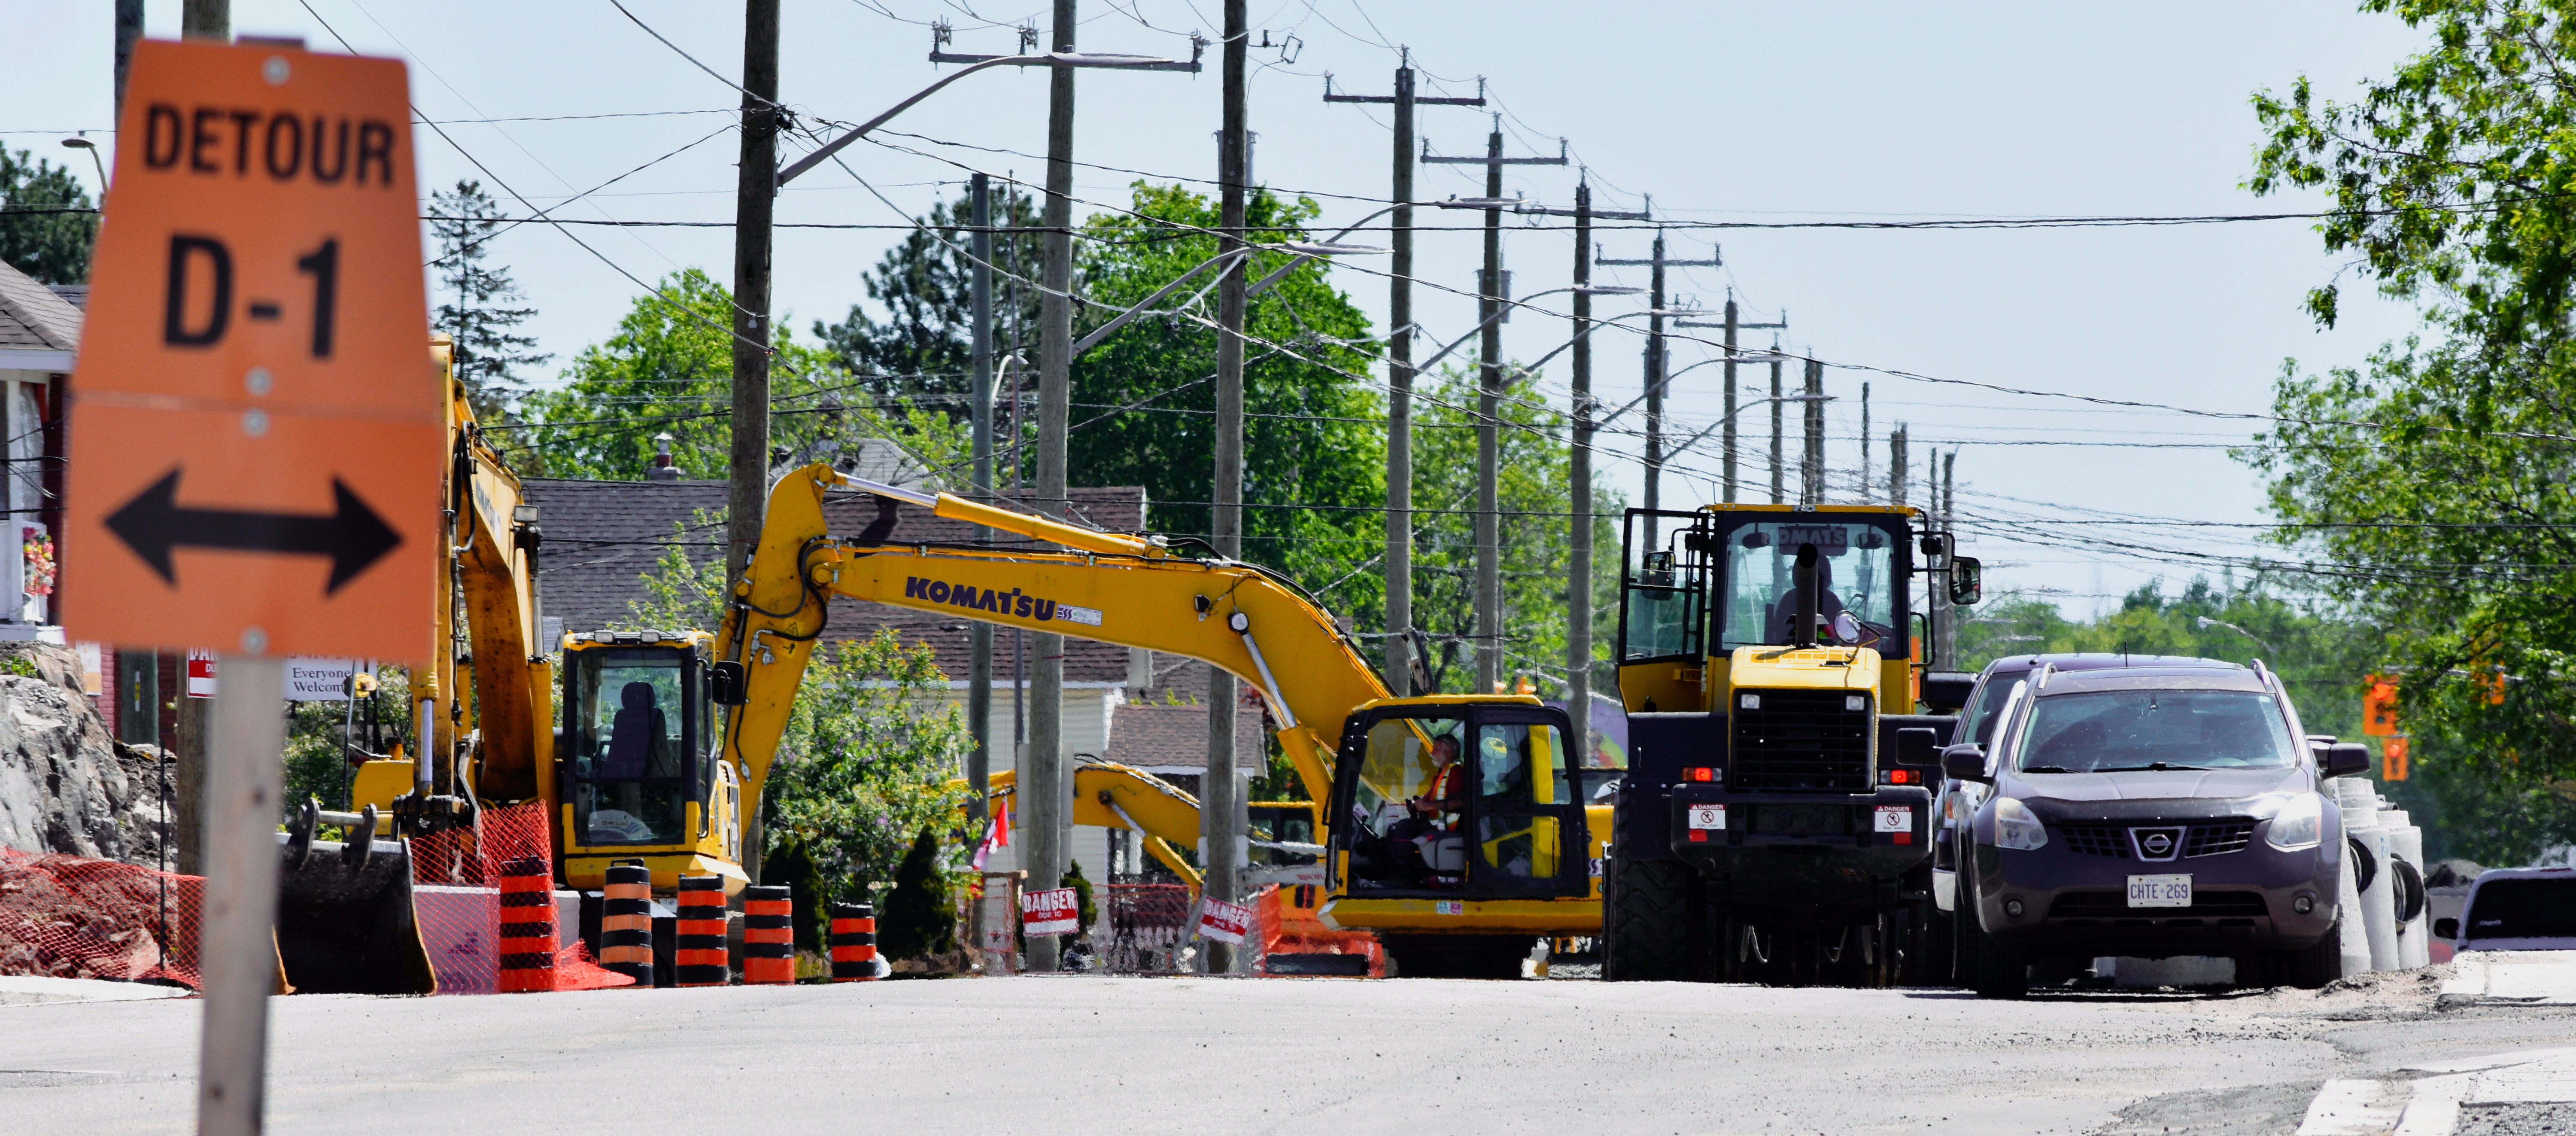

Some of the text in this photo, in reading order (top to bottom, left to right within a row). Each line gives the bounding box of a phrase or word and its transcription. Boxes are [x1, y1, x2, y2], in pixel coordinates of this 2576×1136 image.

[145, 103, 394, 187] DETOUR
[164, 234, 339, 358] D-1
[905, 576, 1056, 621] KOMATSU
[292, 667, 350, 680] Everyone
[294, 682, 343, 692] Welcom
[1023, 890, 1075, 913] DANGER
[2130, 884, 2188, 899] CHTE 269
